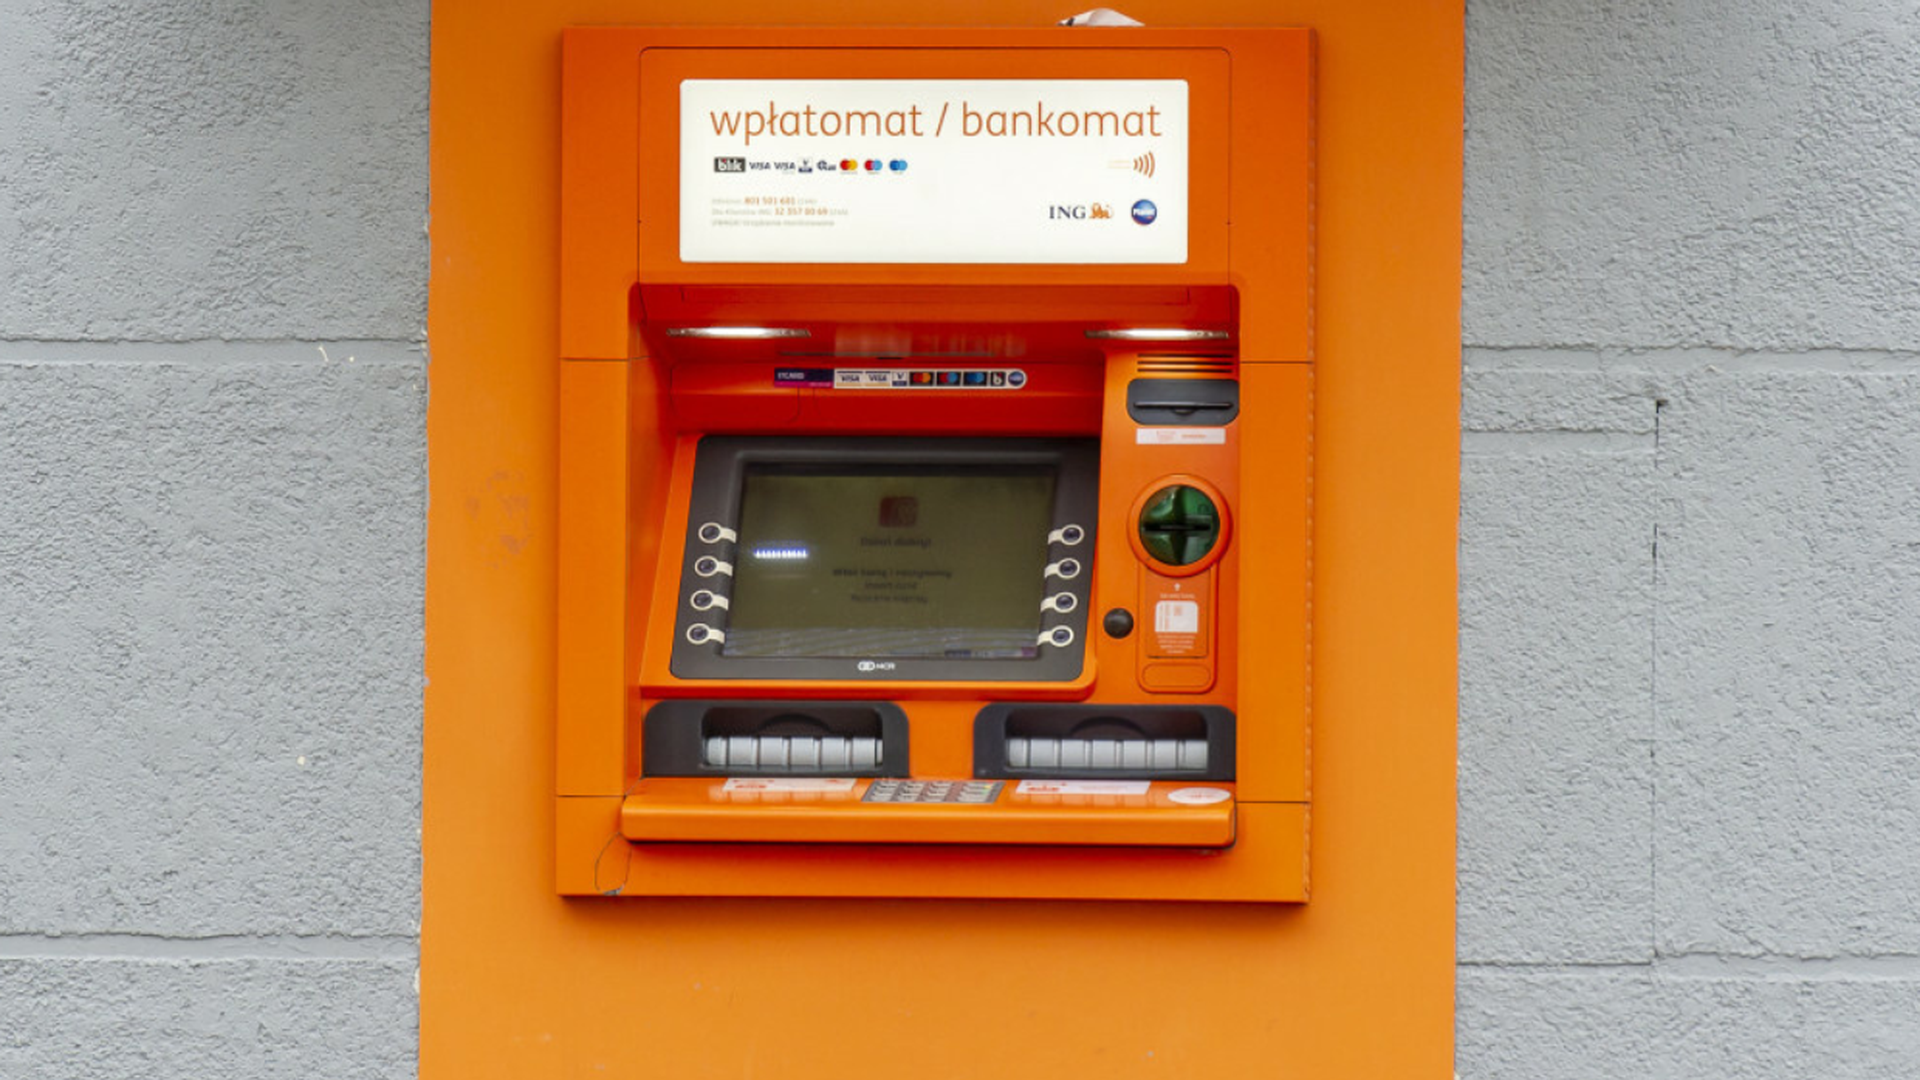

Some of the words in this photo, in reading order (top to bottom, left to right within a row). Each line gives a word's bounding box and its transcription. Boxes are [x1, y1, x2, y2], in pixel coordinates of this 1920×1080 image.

[710, 100, 924, 146] wpłatomat
[935, 101, 949, 137] /
[962, 100, 1162, 137] bankomat
[749, 161, 771, 170] VISA
[774, 161, 796, 170] VISA
[1049, 205, 1086, 220] ING
[840, 373, 860, 382] VISA
[868, 373, 888, 382] VISA
